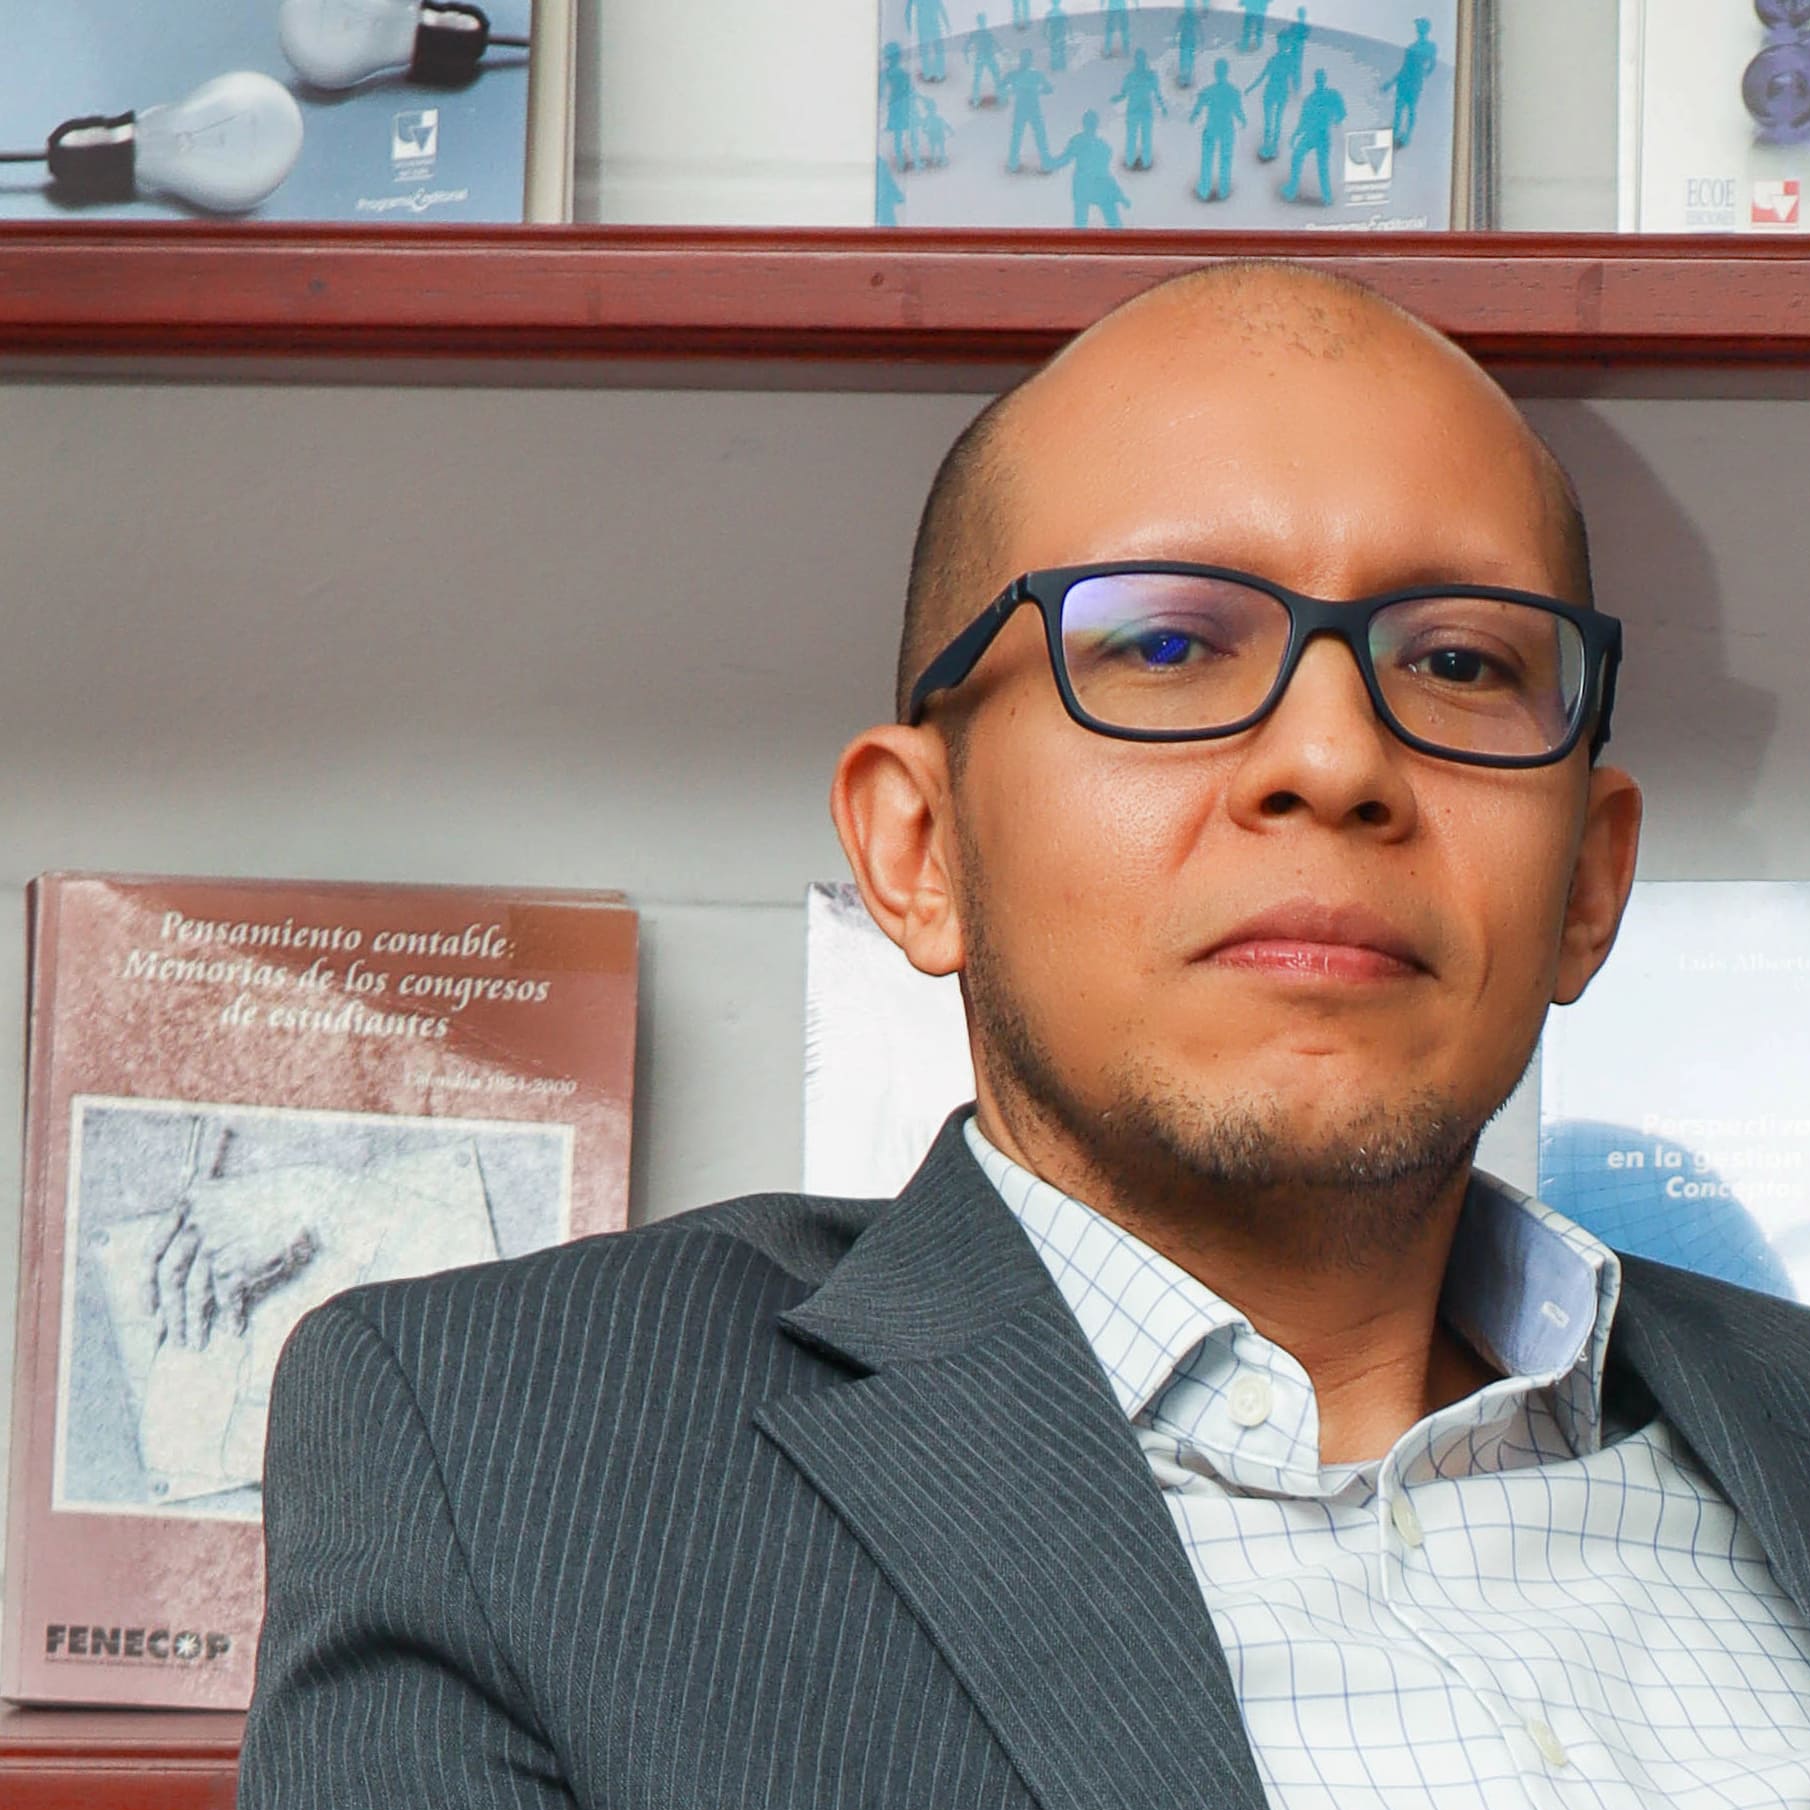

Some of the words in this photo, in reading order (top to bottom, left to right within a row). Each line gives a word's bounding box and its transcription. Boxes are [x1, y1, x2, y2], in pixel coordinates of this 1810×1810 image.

[1687, 178, 1736, 207] ECOE
[159, 910, 362, 950] Pensamiento
[372, 923, 517, 960] contable:
[122, 949, 289, 987] Memorias
[297, 956, 335, 990] de
[344, 959, 389, 993] los
[397, 972, 552, 1012] congresos
[218, 991, 258, 1027] de
[267, 999, 449, 1038] estudiantes
[1607, 1150, 1645, 1168] en
[1654, 1145, 1684, 1168] la
[46, 1624, 232, 1660] FENECOP
